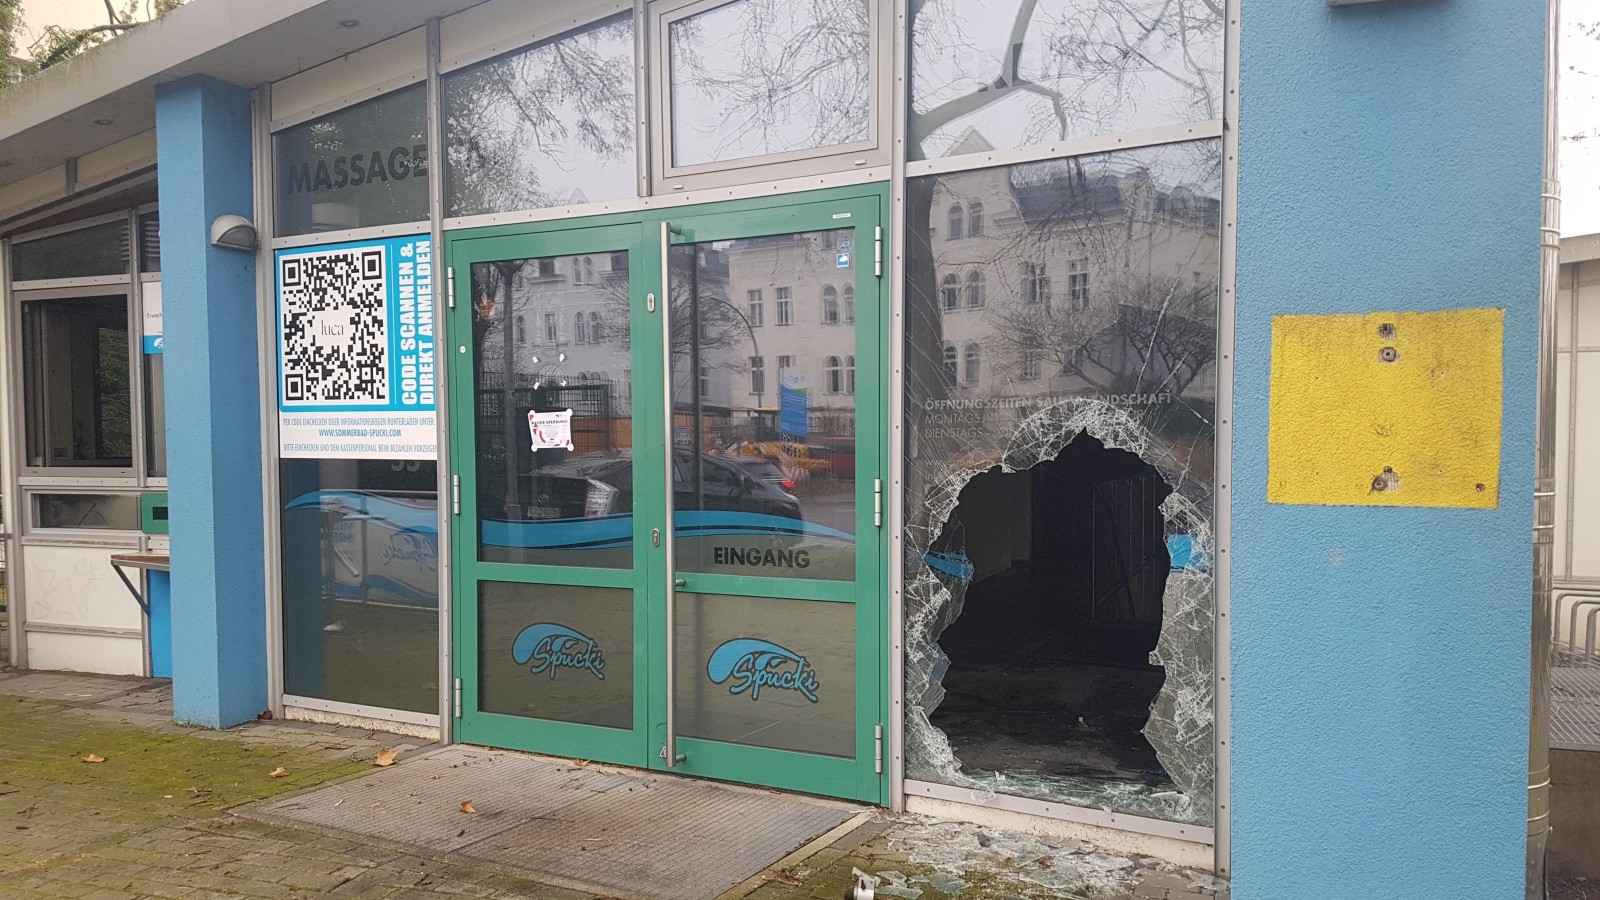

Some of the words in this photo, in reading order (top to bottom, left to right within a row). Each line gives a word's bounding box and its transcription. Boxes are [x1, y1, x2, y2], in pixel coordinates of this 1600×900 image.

[288, 144, 427, 195] MASSAGE
[400, 243, 413, 257] &
[416, 241, 433, 337] ANMELDEN
[399, 262, 416, 351] SCANNEN
[321, 319, 344, 336] luca
[401, 354, 417, 405] CODE
[418, 340, 434, 405] DIREKT
[924, 397, 1032, 410] ÖFFNUNGSZEITEN
[283, 418, 291, 426] PER
[291, 418, 302, 426] CODE
[303, 418, 327, 426] EINCHECKEN
[328, 418, 340, 426] ODER
[341, 417, 387, 426] INFORMATIONSBOGEN
[387, 417, 419, 426] RUNTERLADEN
[420, 417, 436, 426] UNTER:
[319, 428, 402, 437] WWW.SOMMERBAD-SPUCKI.COM
[924, 427, 983, 439] DIENSTAGS
[283, 444, 294, 452] BITTE
[294, 444, 319, 452] EINCHECKEN
[320, 444, 330, 452] UND
[330, 444, 340, 452] DEM
[340, 444, 378, 452] KASSENPERSONAL
[378, 444, 390, 453] BEIM
[390, 444, 413, 453] BEZAHLEN
[714, 546, 811, 569] EINGANG
[531, 637, 606, 680] Spucki
[729, 652, 820, 703] Spucki
